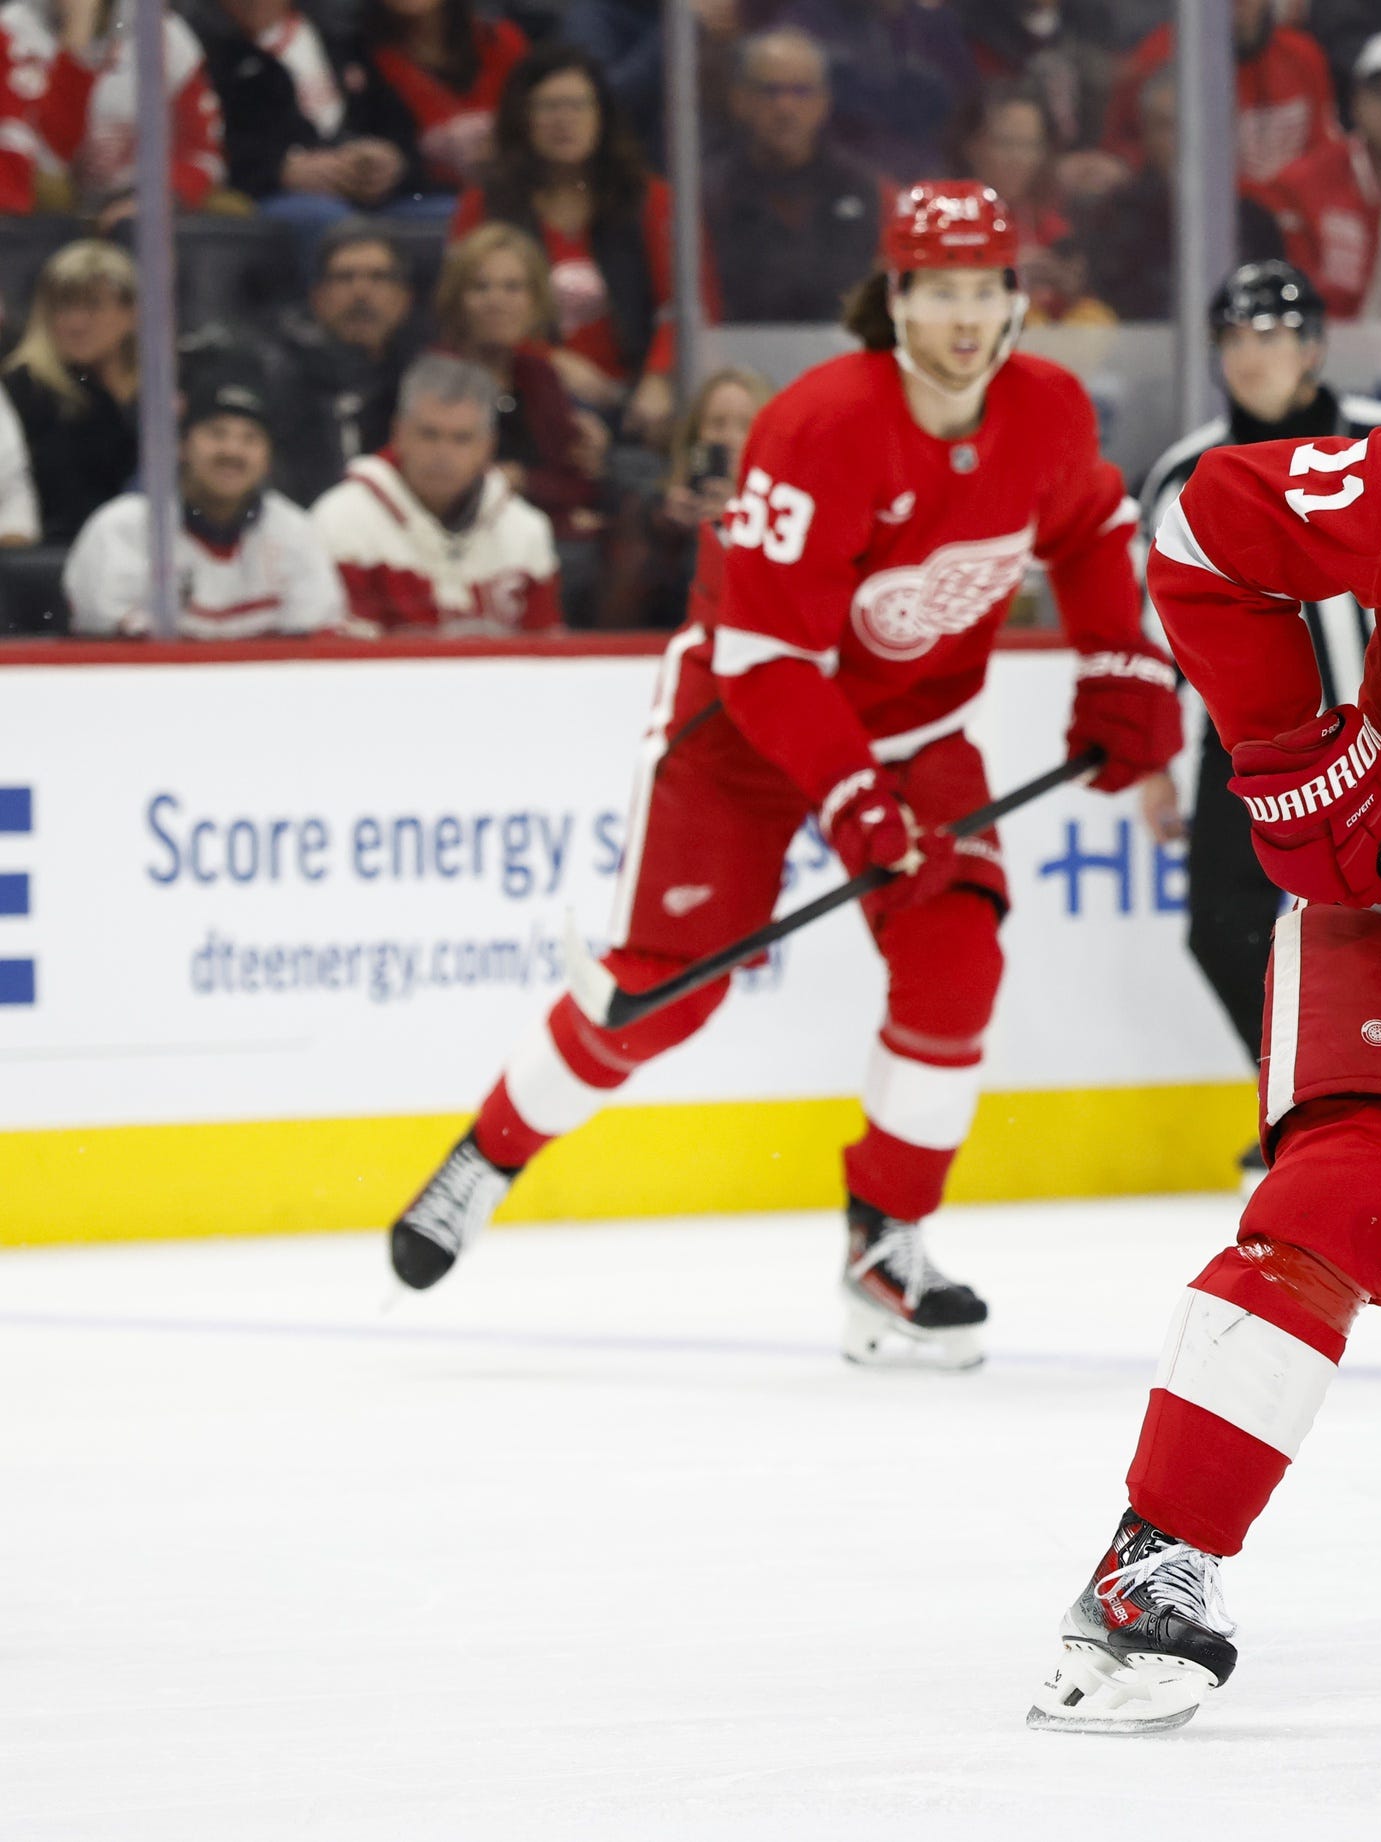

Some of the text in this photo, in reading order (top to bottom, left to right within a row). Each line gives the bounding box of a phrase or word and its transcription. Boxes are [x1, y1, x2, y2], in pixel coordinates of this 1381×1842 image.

[724, 466, 816, 565] 53
[145, 792, 329, 887] Score
[351, 811, 574, 898] energy
[1346, 794, 1375, 828] COVERT
